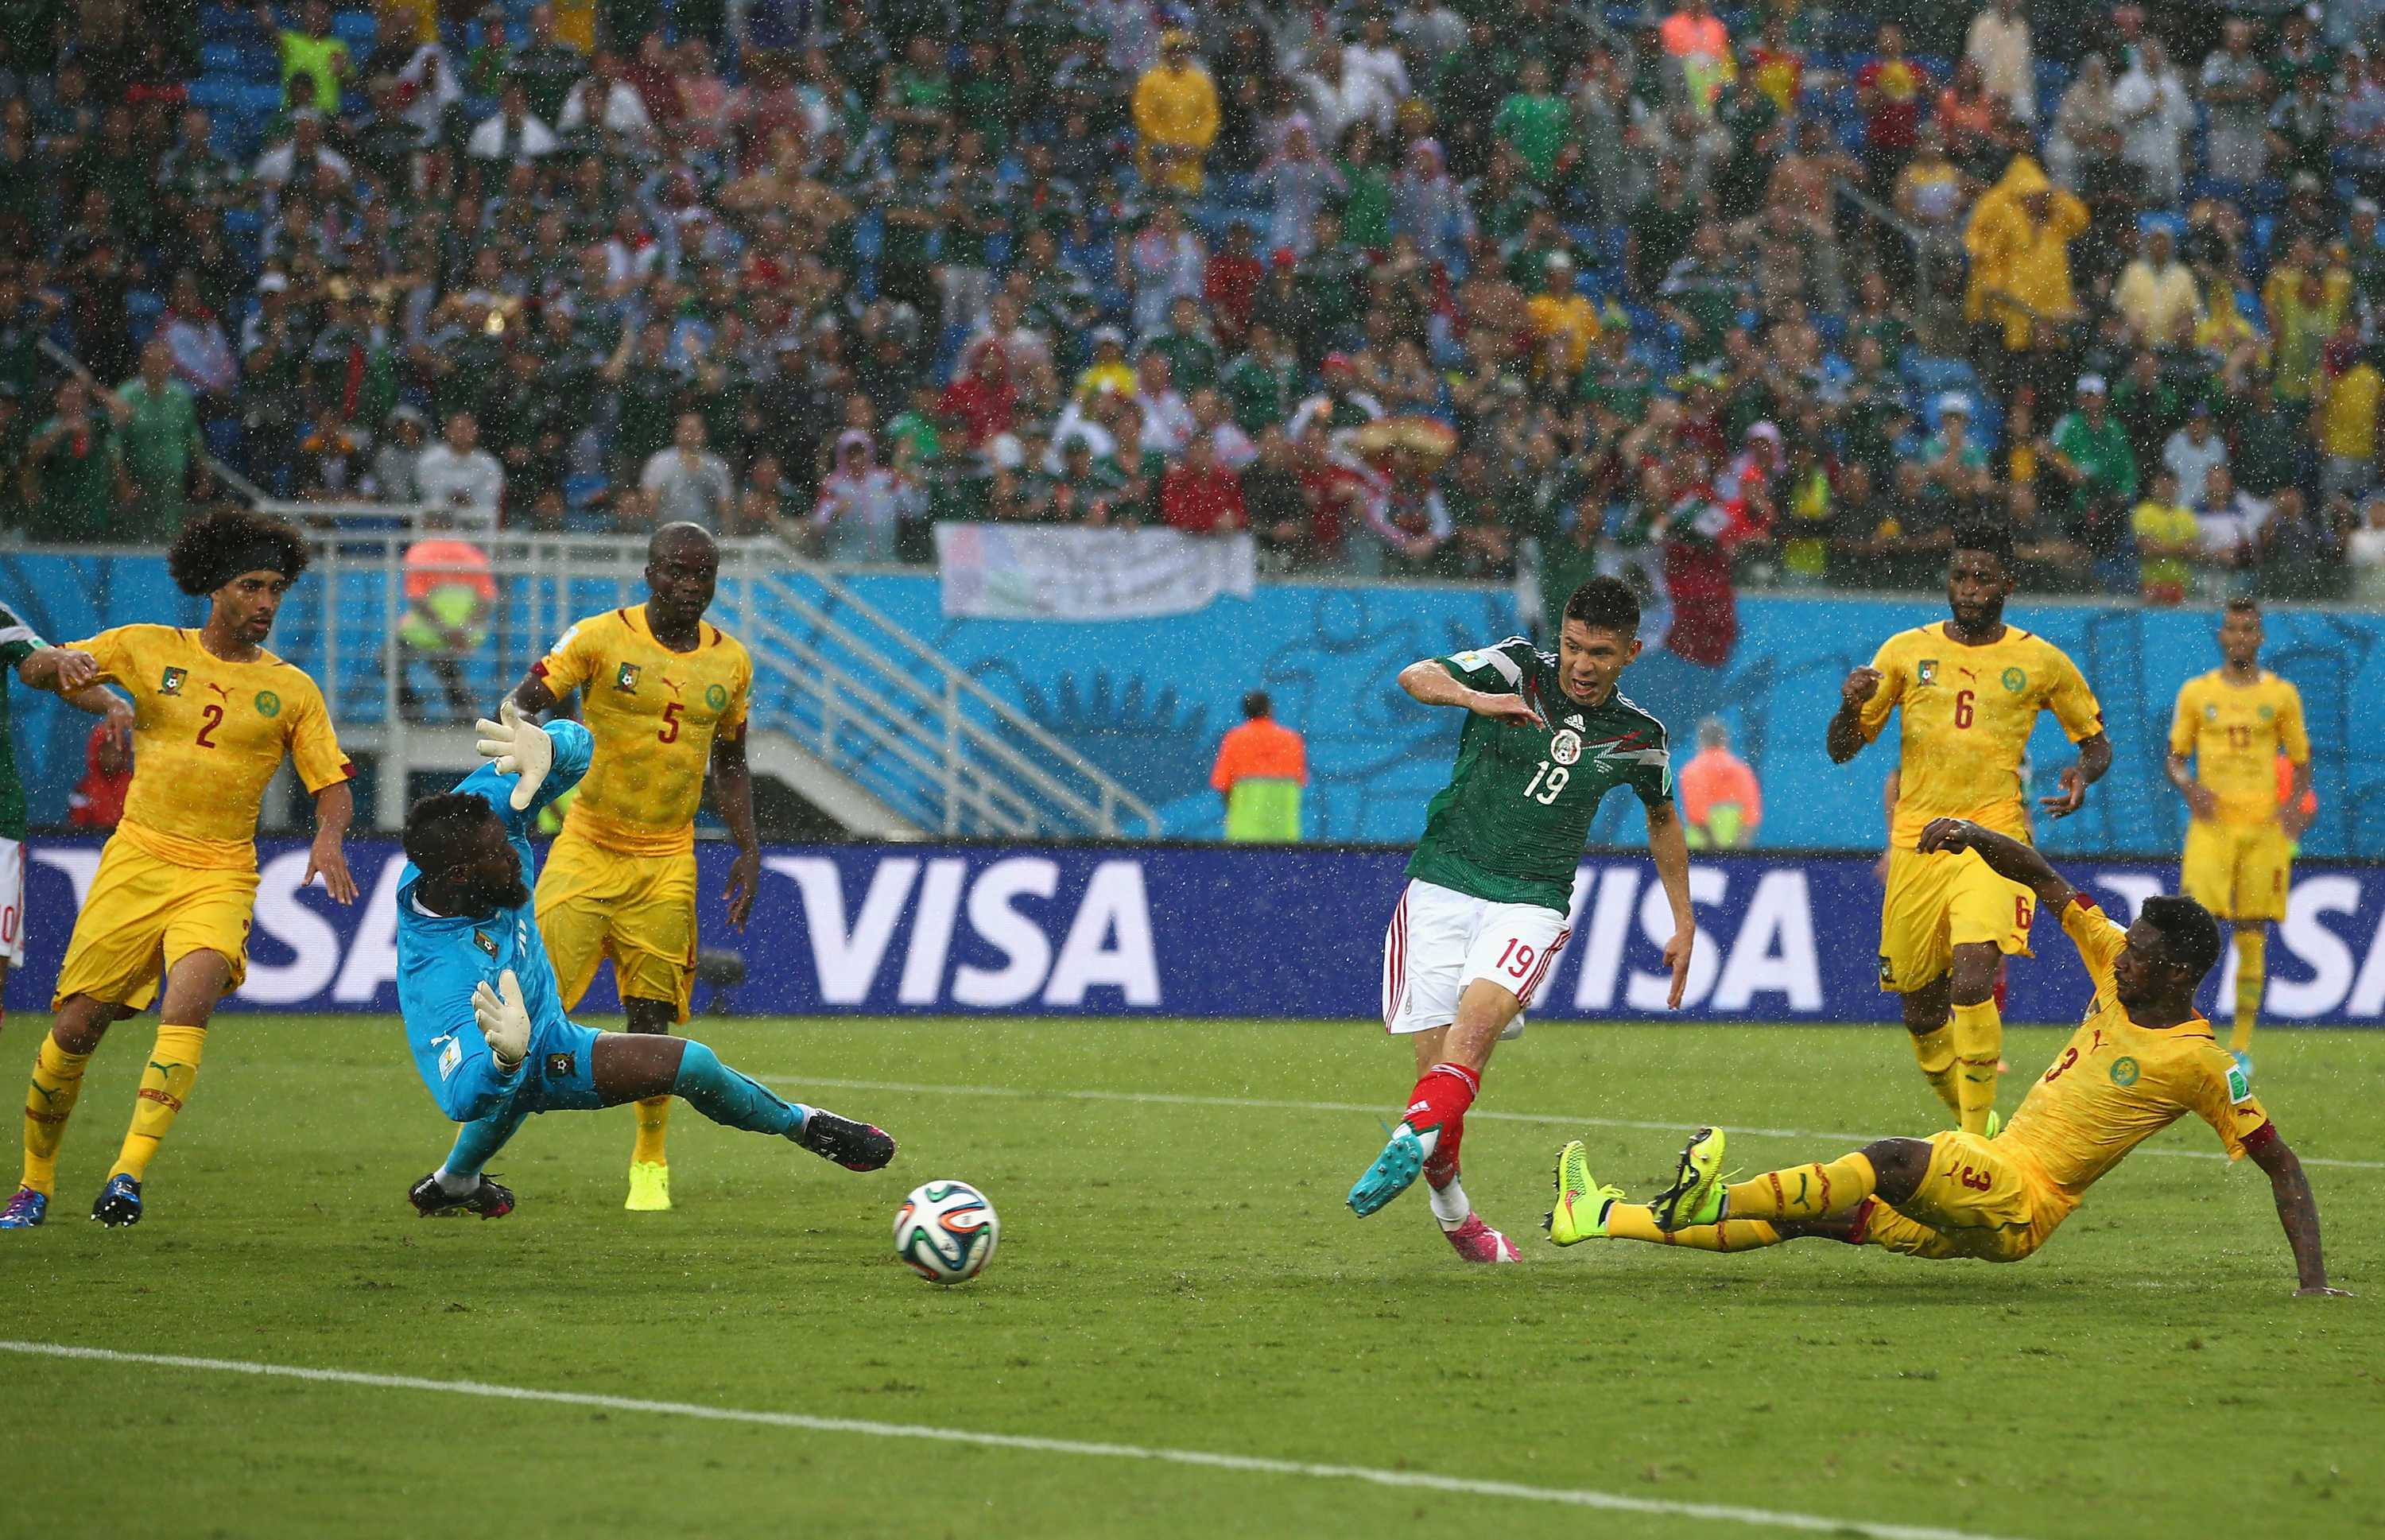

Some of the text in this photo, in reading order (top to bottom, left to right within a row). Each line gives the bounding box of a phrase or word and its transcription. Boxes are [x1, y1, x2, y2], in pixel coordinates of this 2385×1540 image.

[196, 704, 223, 749] 2
[658, 702, 684, 744] 5
[1956, 690, 1975, 730] 6
[1523, 760, 1570, 805] 19
[762, 856, 1163, 1007] VISA
[2016, 895, 2033, 929] 6
[1495, 937, 1535, 979] 19
[2046, 1047, 2079, 1083] 3
[1962, 1166, 1992, 1193] 3
